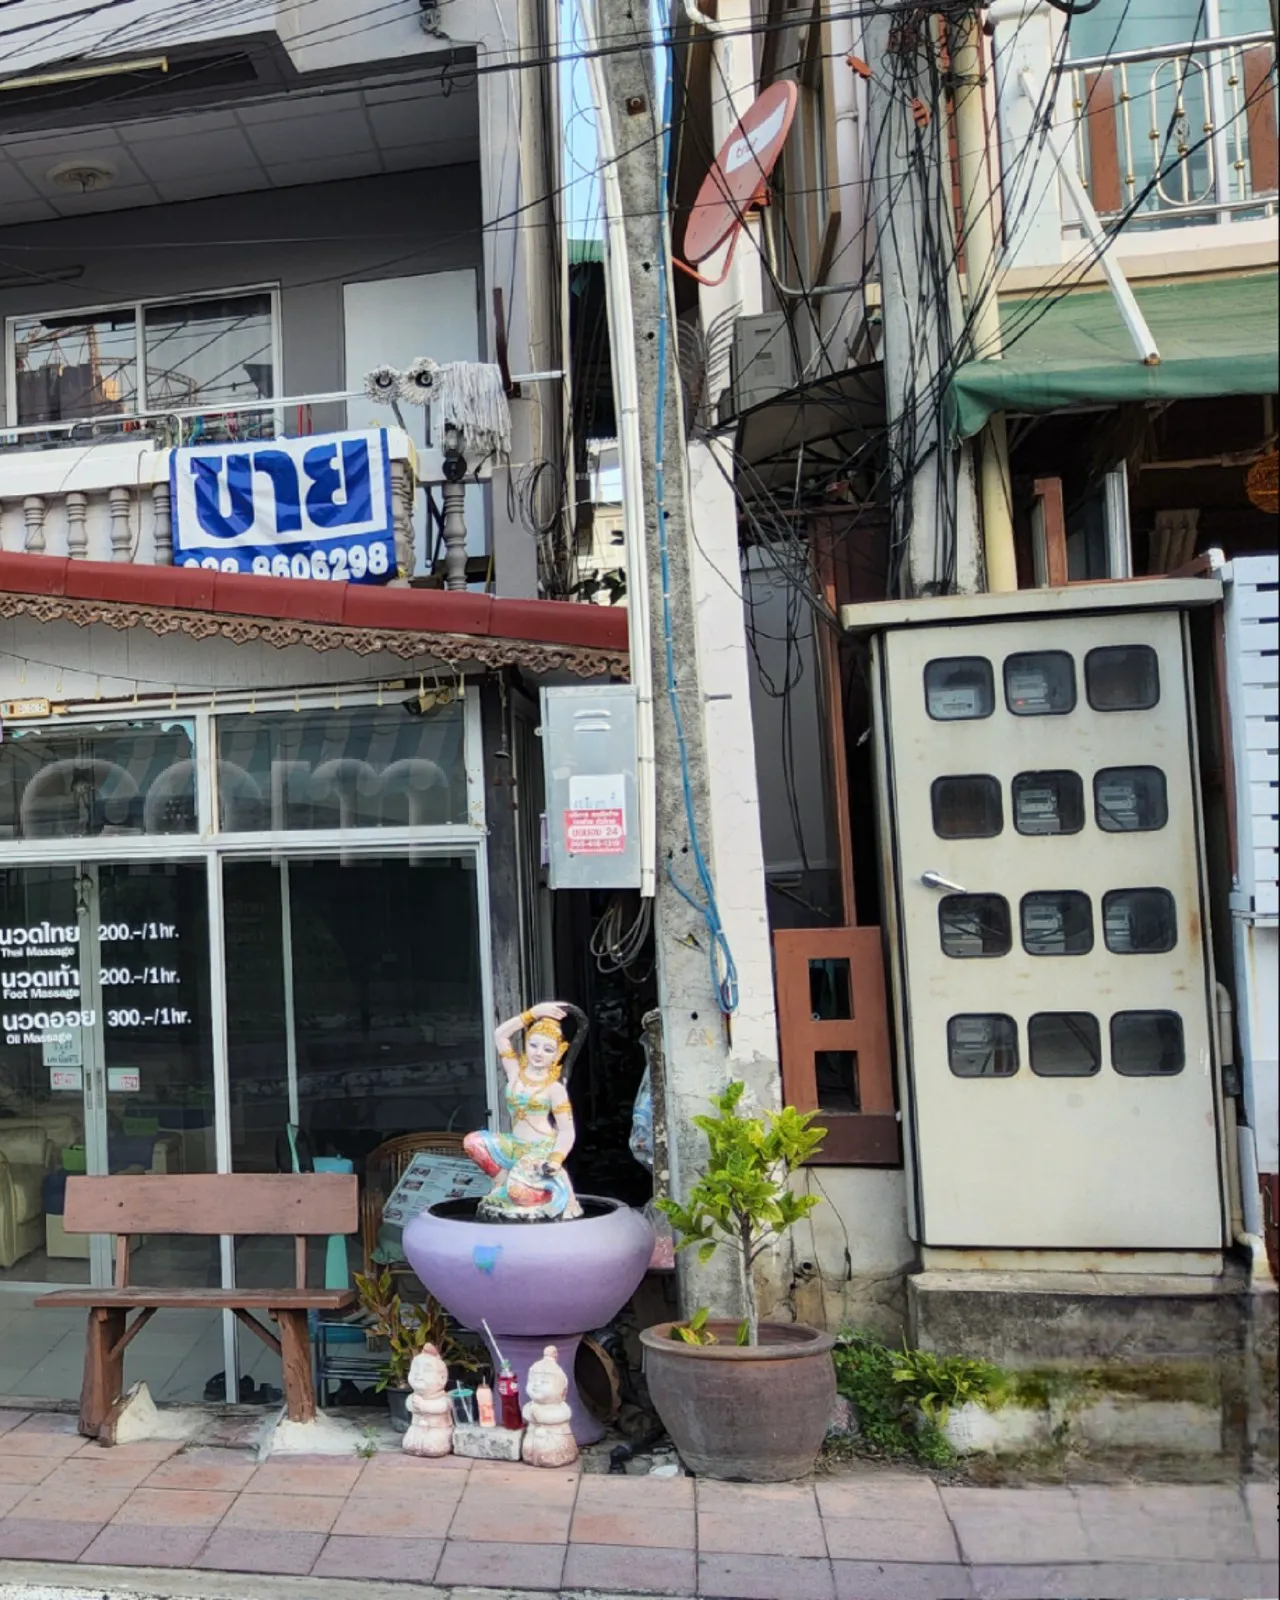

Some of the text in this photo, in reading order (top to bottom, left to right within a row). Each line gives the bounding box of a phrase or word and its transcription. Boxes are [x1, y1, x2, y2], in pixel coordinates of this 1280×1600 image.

[189, 438, 373, 539] ขาย
[26, 946, 75, 958] Massage
[1, 963, 81, 989] นวดเท้า
[3, 988, 81, 999] Foot Massage
[2, 1010, 96, 1031] นวดออย
[6, 1032, 73, 1045] Oil Massage
